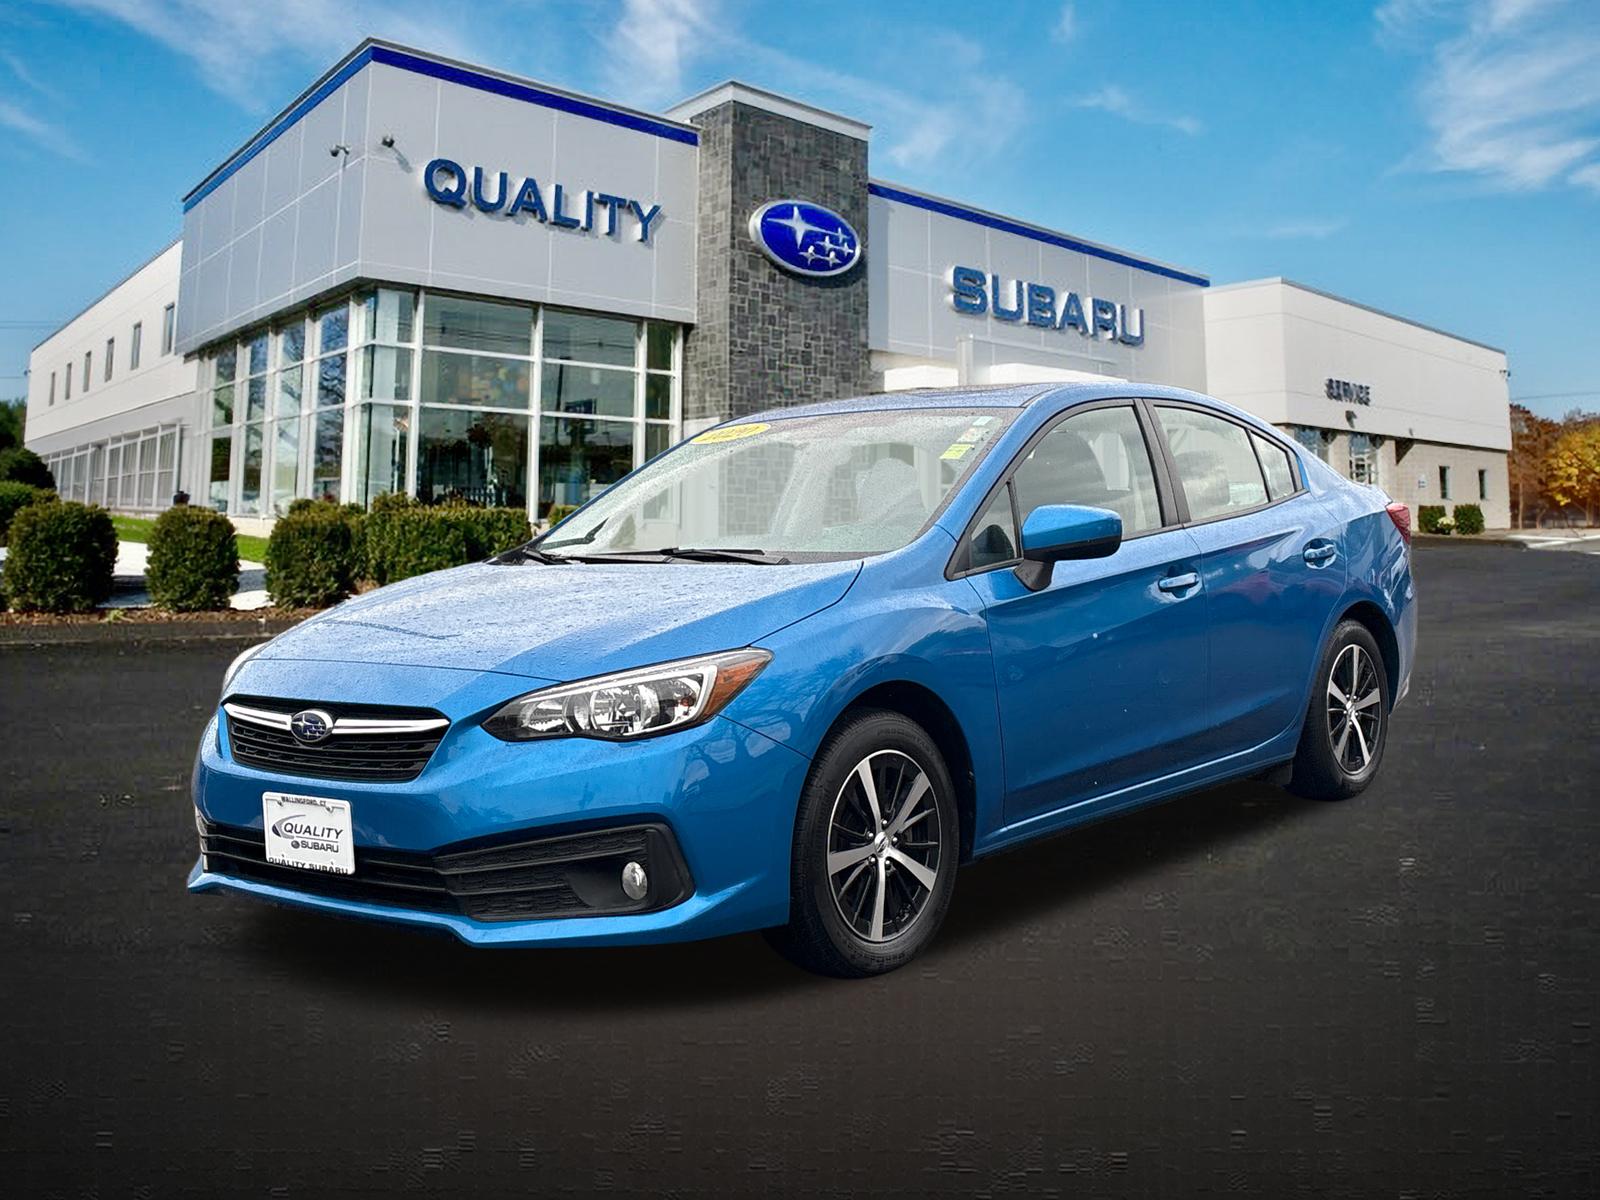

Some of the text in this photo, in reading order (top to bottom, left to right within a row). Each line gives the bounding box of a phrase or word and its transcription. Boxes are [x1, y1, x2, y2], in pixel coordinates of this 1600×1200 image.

[424, 158, 661, 242] QUALITY
[950, 265, 1145, 347] SUBARU
[1325, 378, 1370, 406] SERVICE
[284, 822, 343, 839] QUALITY
[300, 840, 340, 853] SUBARU
[268, 857, 349, 875] QUALITY SUBARU
